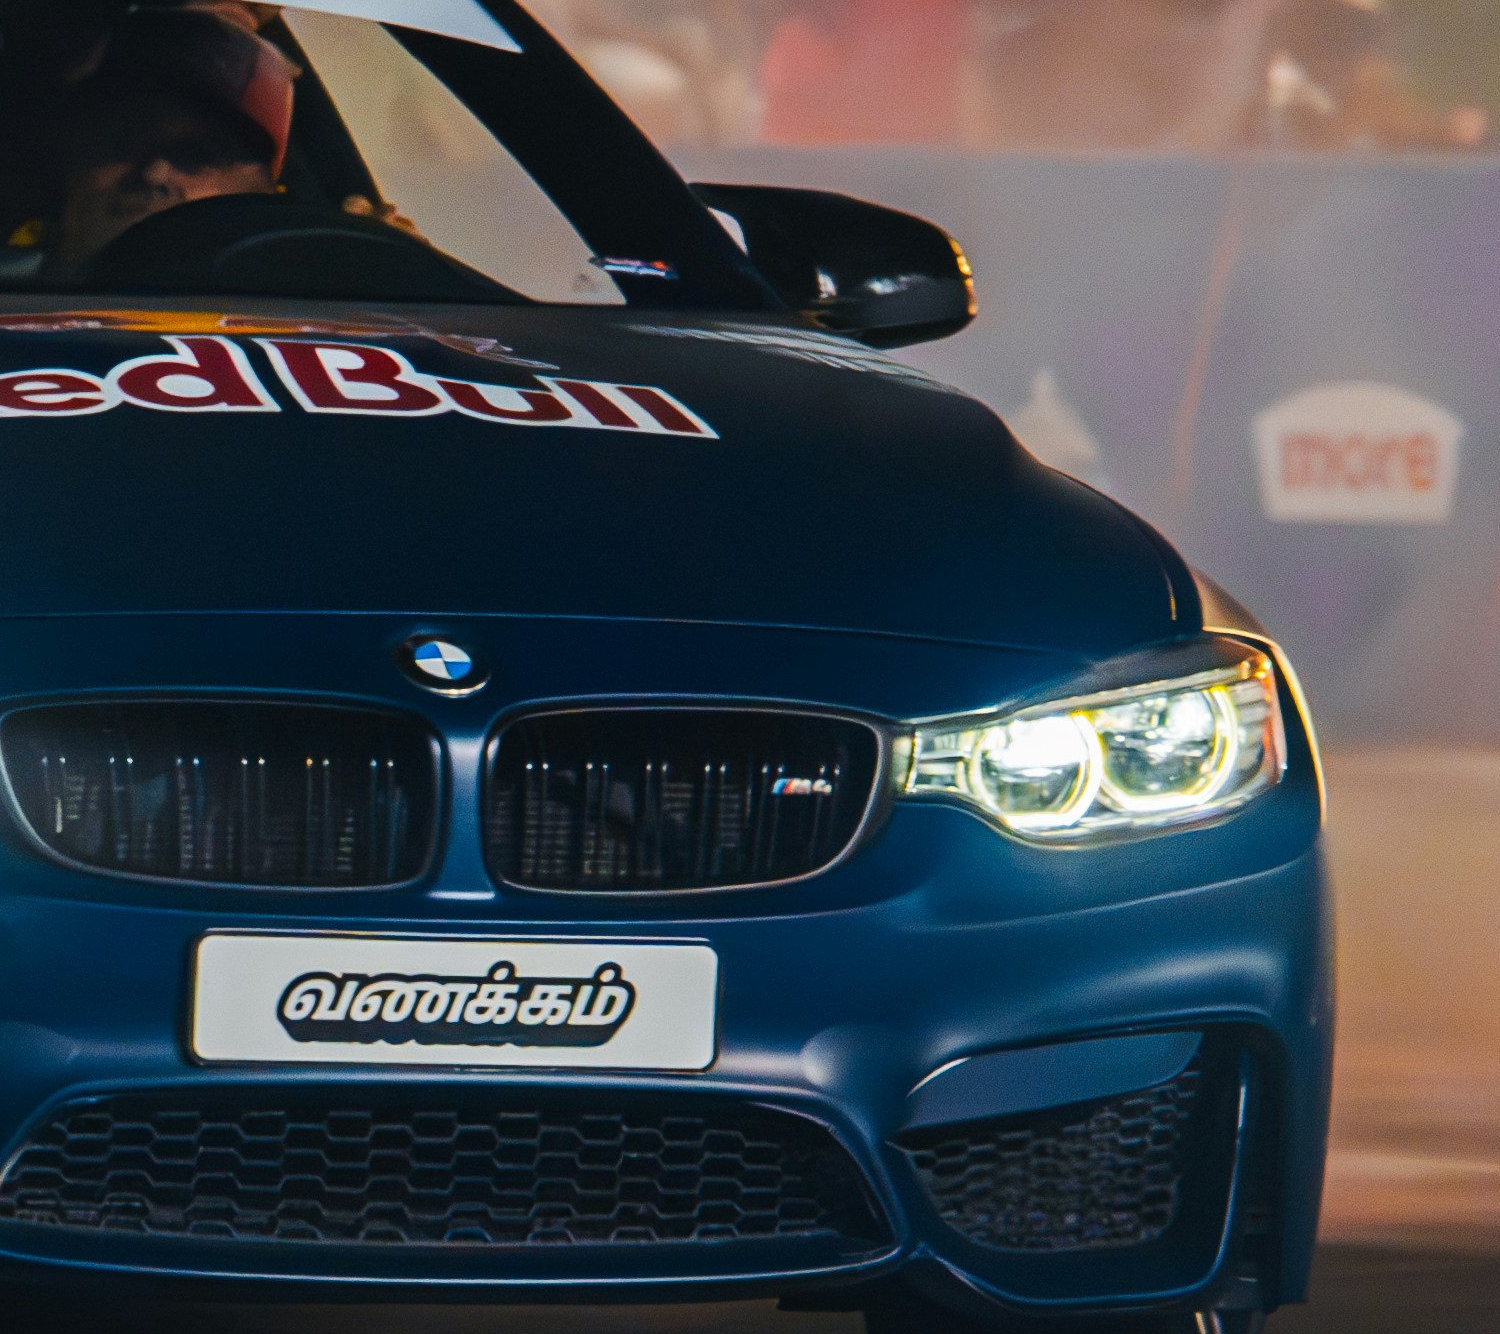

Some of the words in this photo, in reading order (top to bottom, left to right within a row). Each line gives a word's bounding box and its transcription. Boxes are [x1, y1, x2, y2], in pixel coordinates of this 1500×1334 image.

[256, 338, 719, 439] Bull
[1280, 433, 1440, 493] more
[277, 960, 636, 1047] வணக்கம்
